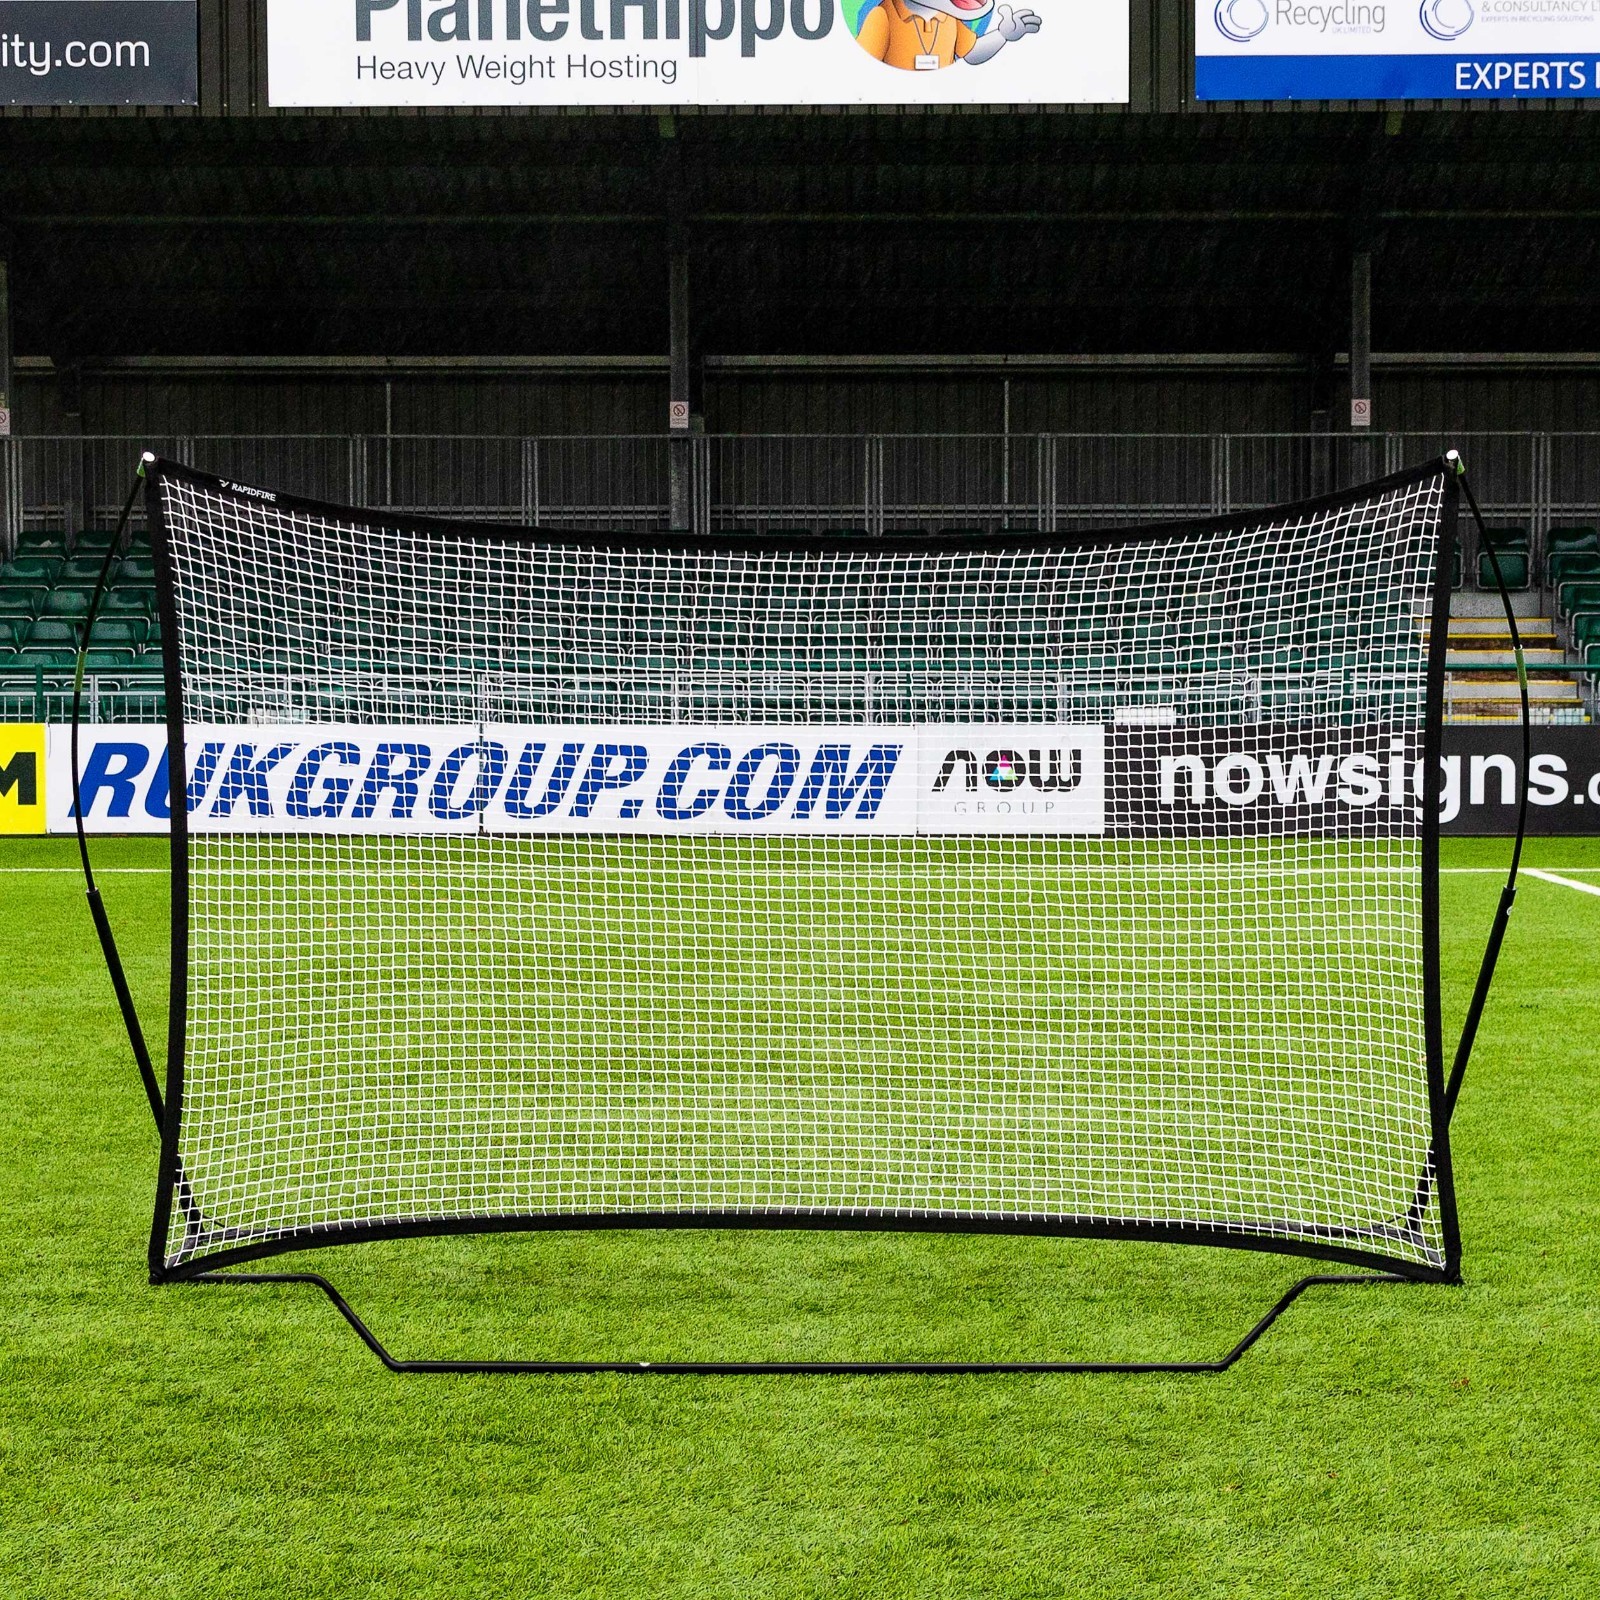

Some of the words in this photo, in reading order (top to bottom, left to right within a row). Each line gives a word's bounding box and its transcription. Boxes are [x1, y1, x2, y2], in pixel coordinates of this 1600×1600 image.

[1276, 0, 1385, 33] Recycling
[1494, 0, 1587, 12] CONSULTANCY
[2, 33, 149, 76] ity.com
[357, 54, 446, 86] Heavy
[456, 53, 555, 86] Weight
[567, 53, 677, 85] Hosting
[1455, 61, 1586, 90] EXPERTS
[231, 482, 277, 502] RAPIDFIRE
[67, 742, 903, 819] RUKGROUP.COM
[953, 800, 1056, 816] GROUP
